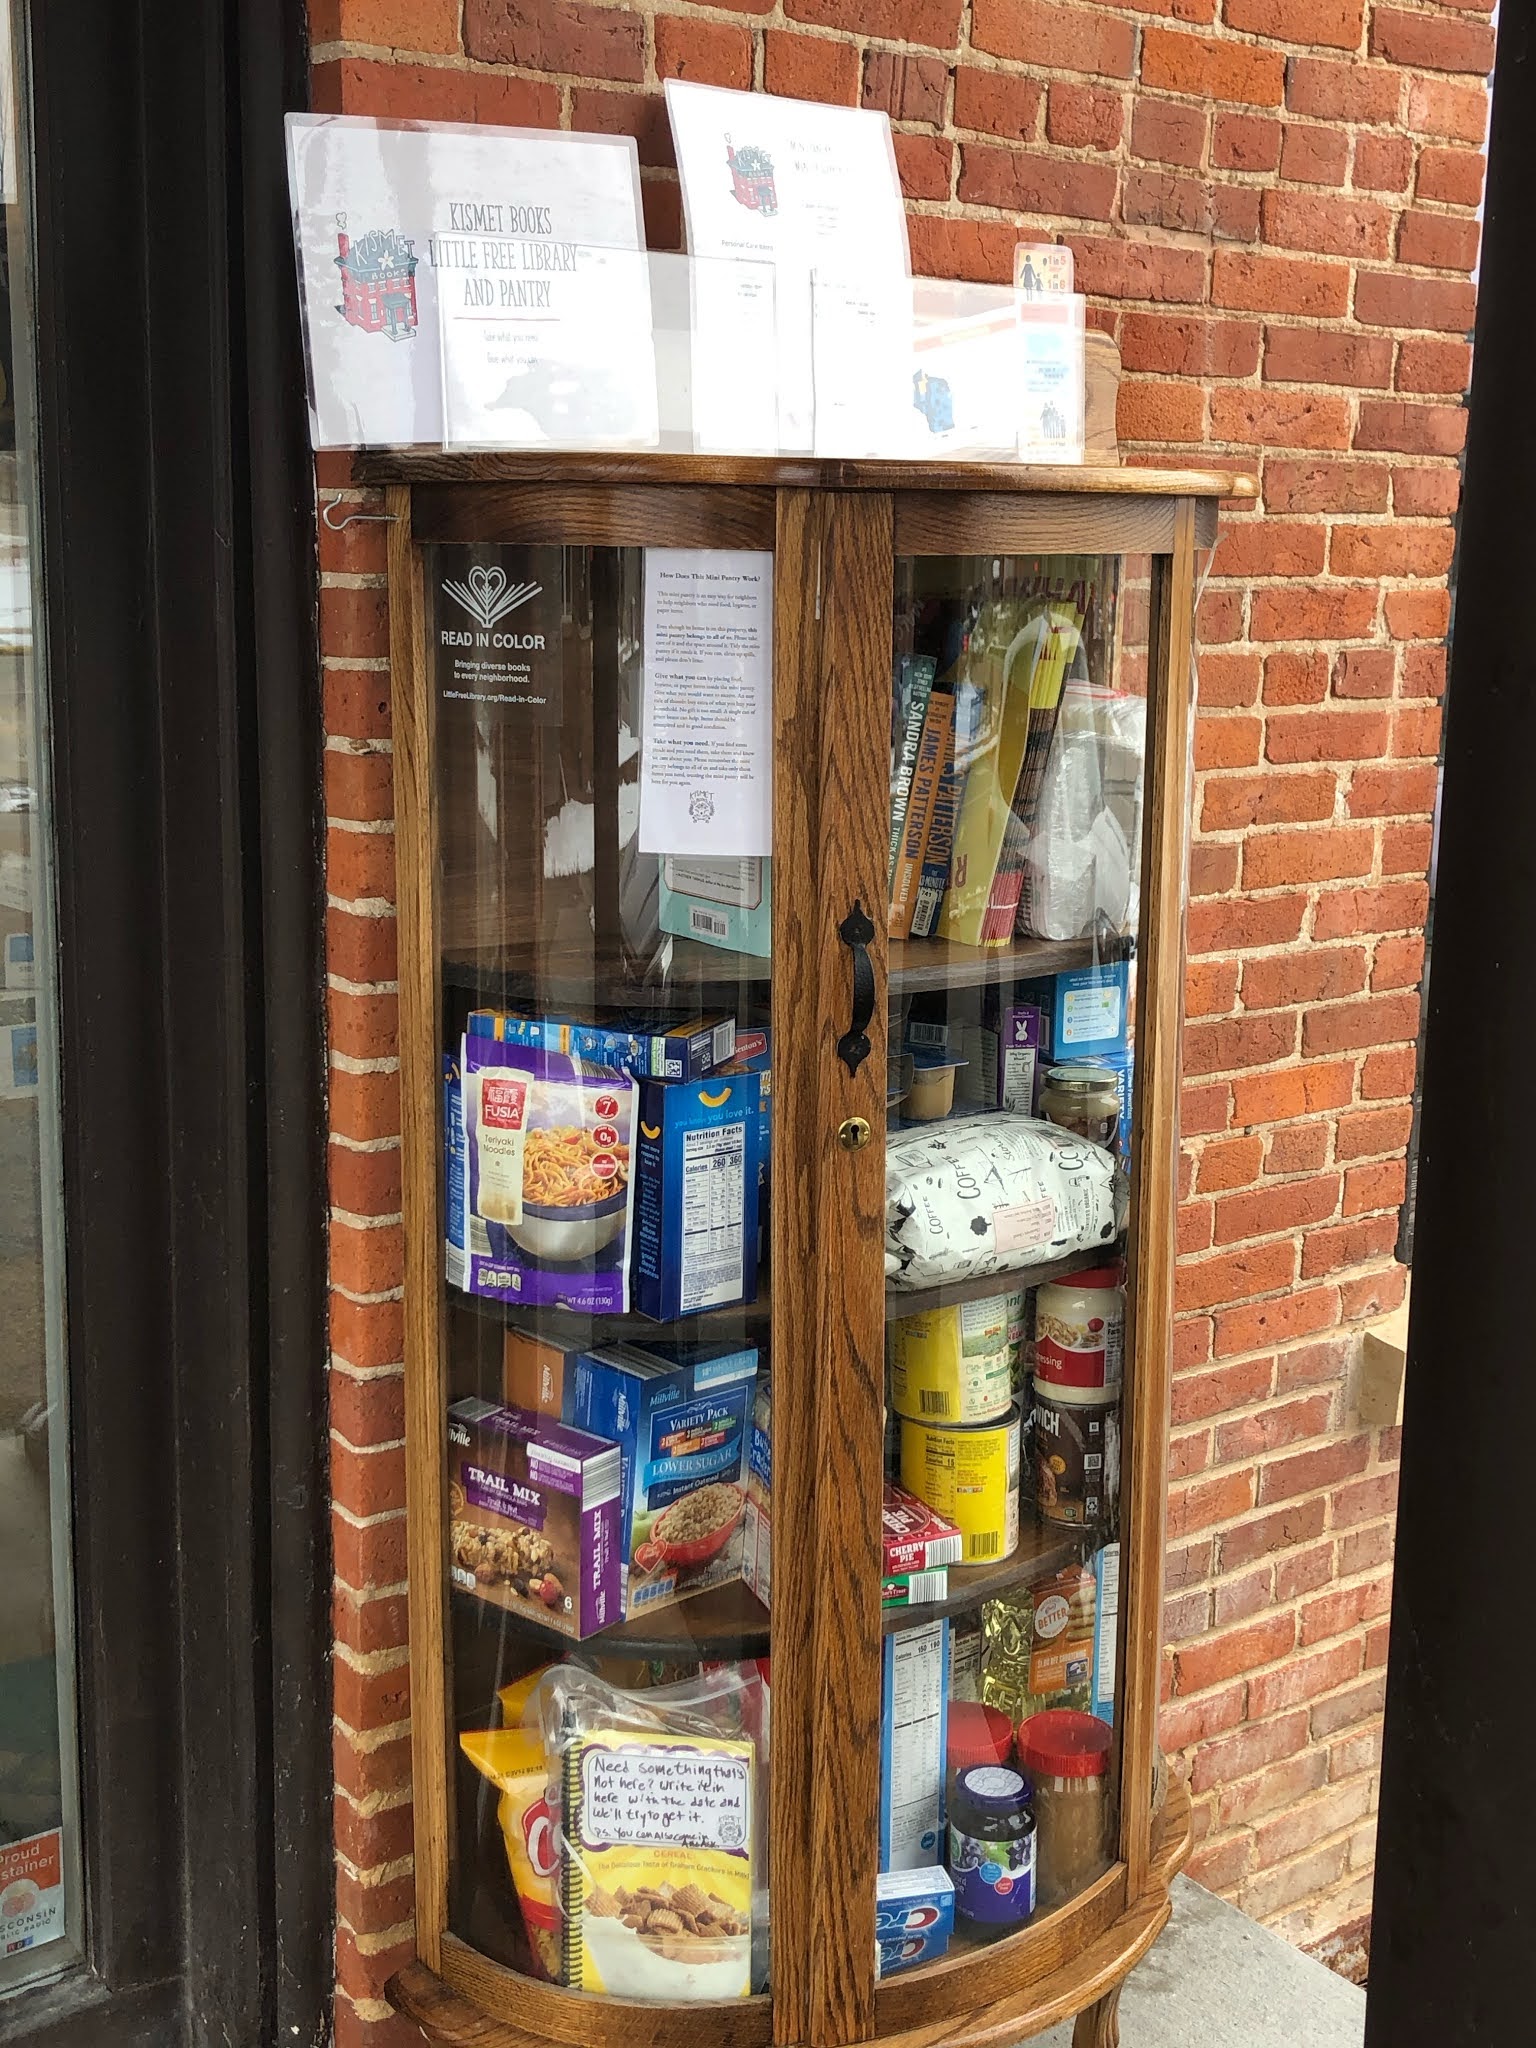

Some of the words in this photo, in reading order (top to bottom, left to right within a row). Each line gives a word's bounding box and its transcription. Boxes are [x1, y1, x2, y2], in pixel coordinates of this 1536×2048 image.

[449, 203, 503, 232] KISMET
[509, 206, 552, 234] BOOKS
[354, 229, 415, 266] KISMET
[428, 240, 478, 268] LITTLE
[482, 241, 516, 270] FREE
[521, 243, 578, 272] LIBRARY
[372, 269, 407, 280] BOOKS
[464, 278, 494, 306] AND
[499, 280, 551, 307] PANTRY
[441, 631, 472, 646] READ
[476, 632, 489, 647] IN
[493, 634, 545, 650] COLOR
[455, 660, 480, 670] Bringing
[481, 662, 506, 671] diverse
[508, 663, 530, 672] books
[461, 673, 478, 681] every
[480, 673, 530, 683] neighborhood.
[443, 690, 546, 704] LittleFreeLibrary.org/Read-in-Color
[902, 701, 925, 766] SANDRA
[919, 726, 941, 772] JAMES
[892, 765, 914, 822] BROWN
[905, 779, 933, 859] PATTERSON
[890, 827, 900, 853] THICK
[900, 862, 913, 902] UNSOLVED
[1117, 1070, 1125, 1119] VARIETY
[485, 1105, 519, 1119] FUSIA
[603, 1100, 611, 1114] 7
[708, 1112, 724, 1125] you
[725, 1110, 743, 1120] love
[745, 1106, 754, 1116] it.
[485, 1134, 514, 1146] Teriyaki
[600, 1132, 611, 1143] 0g
[686, 1129, 721, 1142] Nutrition
[722, 1126, 742, 1136] Facts
[484, 1144, 515, 1156] Noodles
[685, 1164, 708, 1173] Calories
[712, 1158, 726, 1168] 260
[729, 1154, 742, 1165] 360
[942, 1154, 981, 1200] COFFEE
[923, 1195, 944, 1235] COFFEE
[567, 1296, 576, 1304] WT
[577, 1297, 586, 1305] 4.6
[587, 1297, 595, 1305] OZ
[541, 1364, 552, 1403] Millville
[650, 1390, 680, 1407] Millville
[616, 1391, 629, 1432] Millville
[670, 1412, 705, 1432] VARIETY
[707, 1406, 729, 1420] PACK
[530, 1459, 539, 1470] NO
[652, 1459, 693, 1477] LOWER
[696, 1448, 732, 1469] SUGAR
[530, 1470, 538, 1480] NO
[673, 1482, 694, 1495] Instant
[695, 1473, 720, 1487] Oatmeal
[468, 1466, 509, 1492] TRAIL
[513, 1483, 540, 1506] MIX
[592, 1508, 602, 1541] MIX
[890, 1541, 925, 1557] CHERRY
[900, 1553, 914, 1563] PIE
[592, 1542, 602, 1591] TRAIL
[564, 1595, 573, 1610] 6
[1038, 1607, 1066, 1630] BETTER
[896, 1652, 911, 1660] Calories
[918, 1645, 927, 1653] 150
[594, 1757, 629, 1774] Need
[638, 1762, 713, 1786] something
[594, 1776, 615, 1789] Not
[620, 1777, 654, 1791] here?
[660, 1778, 696, 1793] Write
[712, 1781, 725, 1793] in
[594, 1793, 618, 1804] here
[628, 1792, 659, 1805] with
[661, 1794, 685, 1806] the
[690, 1796, 716, 1808] date
[720, 1796, 740, 1808] and
[593, 1808, 622, 1820] We'll
[626, 1810, 647, 1828] try
[647, 1809, 660, 1820] to
[662, 1812, 685, 1827] get
[689, 1811, 705, 1823] it.
[614, 1827, 633, 1839] You
[636, 1831, 654, 1839] can
[653, 1850, 692, 1859] CEREAL
[1, 1854, 54, 1880] stainer
[611, 1861, 641, 1869] Delicious
[642, 1860, 661, 1868] Taste
[669, 1861, 695, 1870] Graham
[696, 1863, 725, 1876] Crackers
